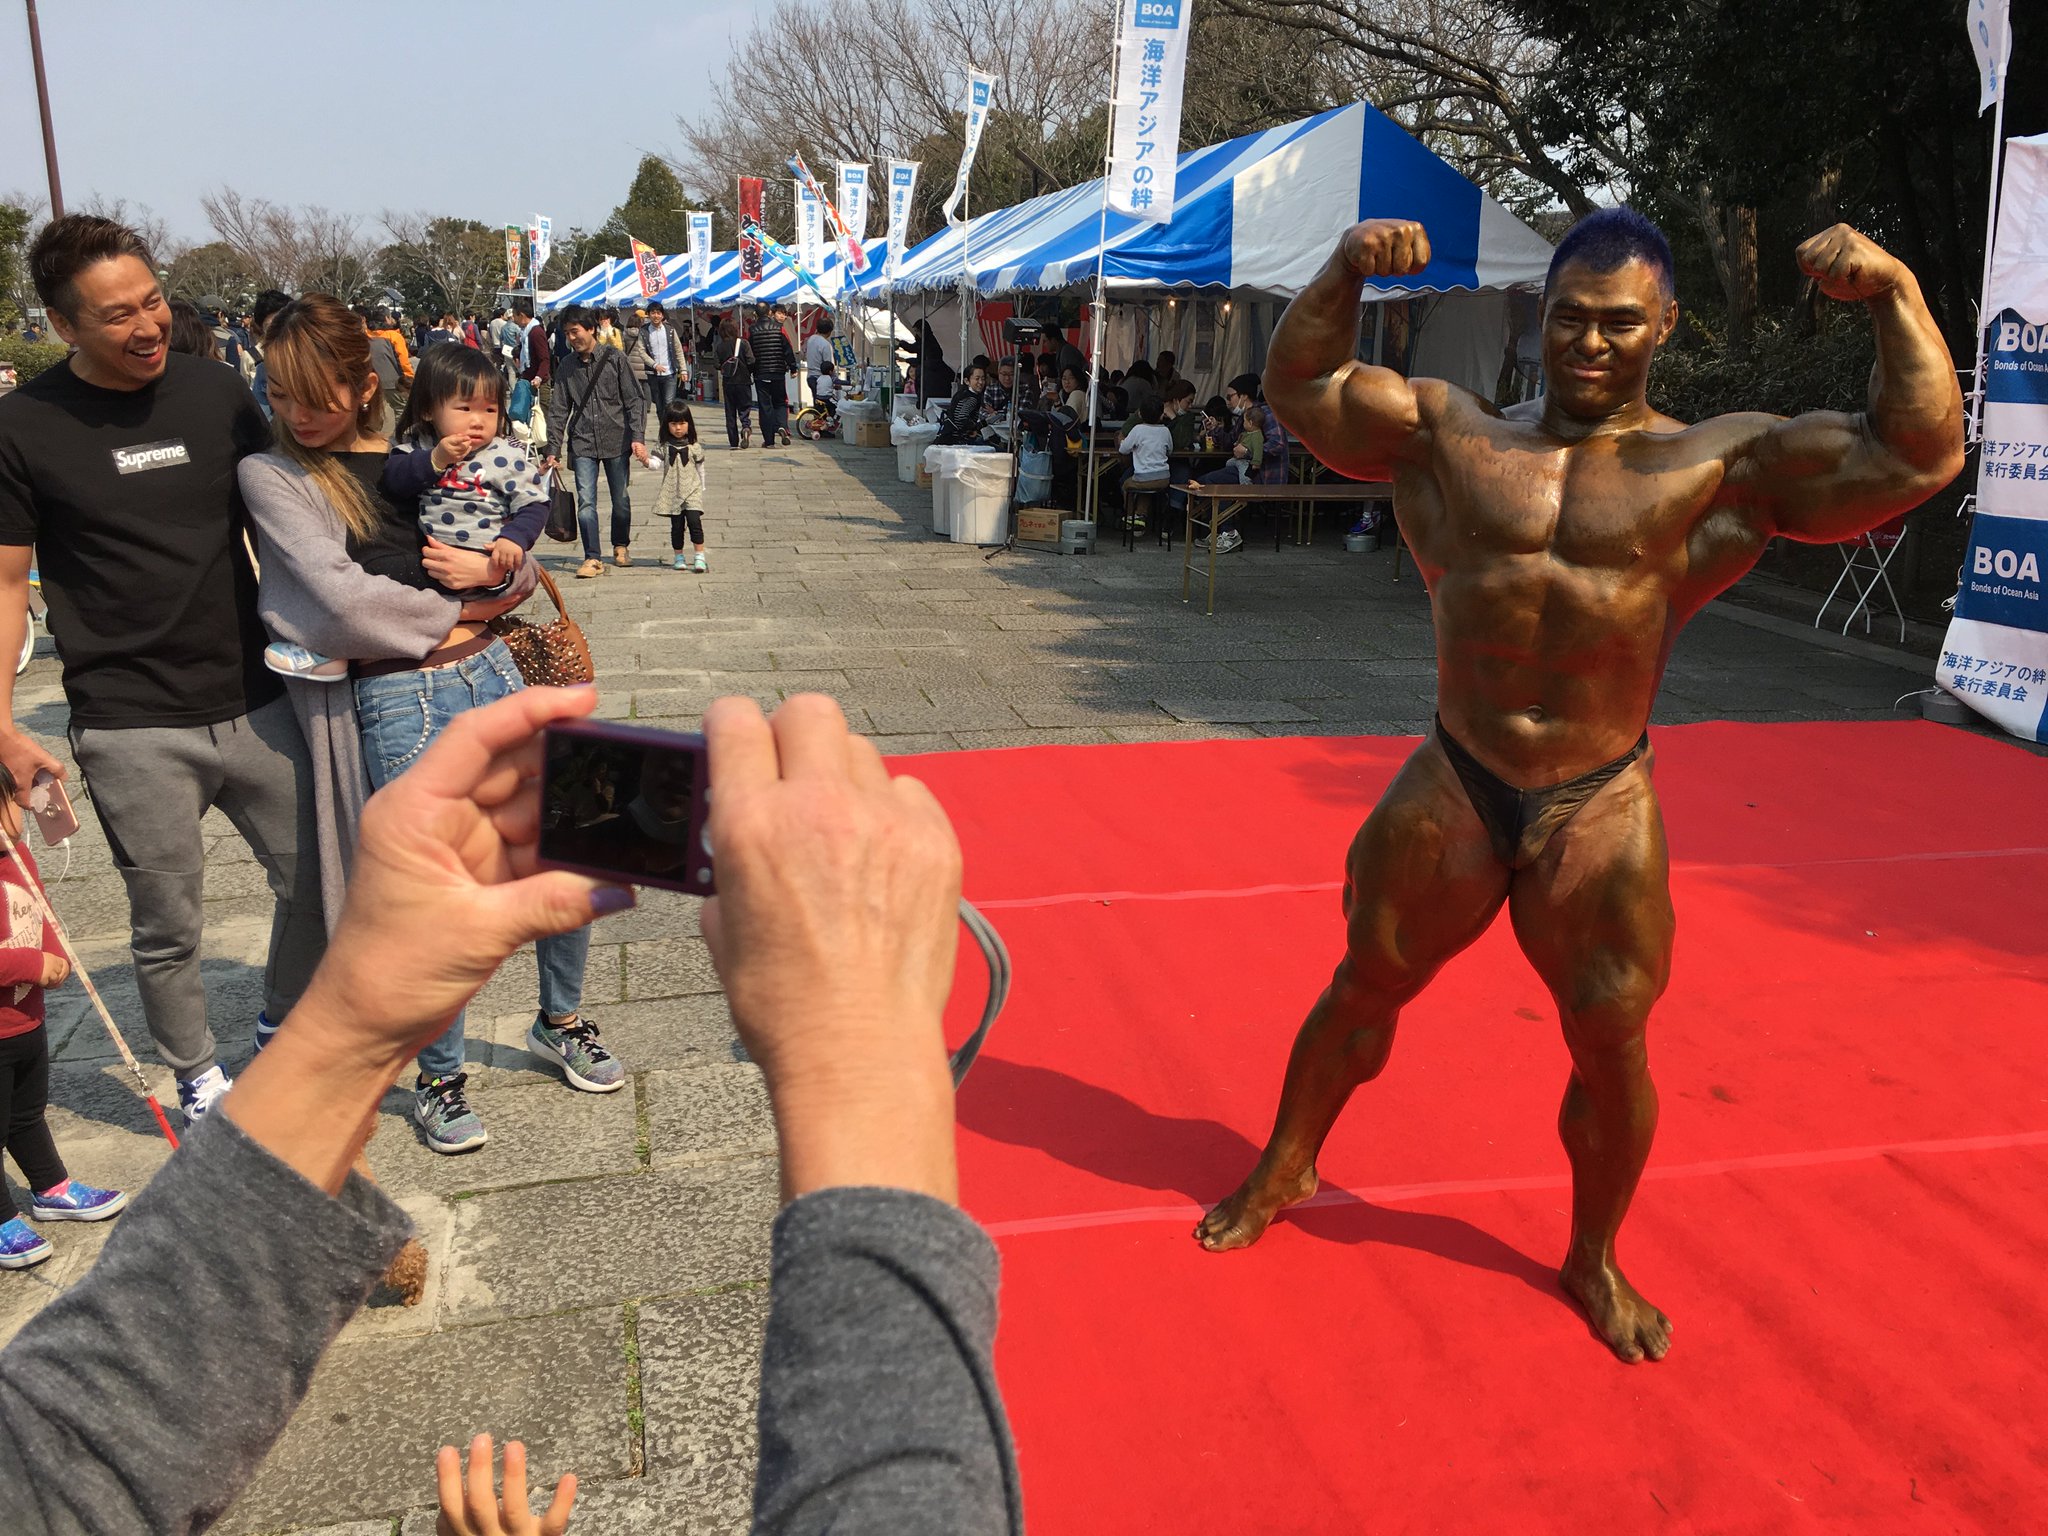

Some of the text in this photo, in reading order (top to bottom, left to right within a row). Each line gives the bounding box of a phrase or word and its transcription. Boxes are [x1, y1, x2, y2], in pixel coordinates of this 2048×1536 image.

[1141, 3, 1175, 17] BOA
[1130, 38, 1165, 210] 海洋アジアの絆
[1994, 360, 2018, 371] Bonds
[2020, 361, 2027, 371] of
[116, 445, 186, 469] Supreme
[1985, 461, 2048, 480] 実行委員会
[1973, 546, 2040, 583] BOA
[1971, 581, 2039, 600] Bonds of Ocean Asia
[1943, 652, 2047, 685] 海洋アジアの絆
[1952, 674, 2028, 702] 実行委員会
